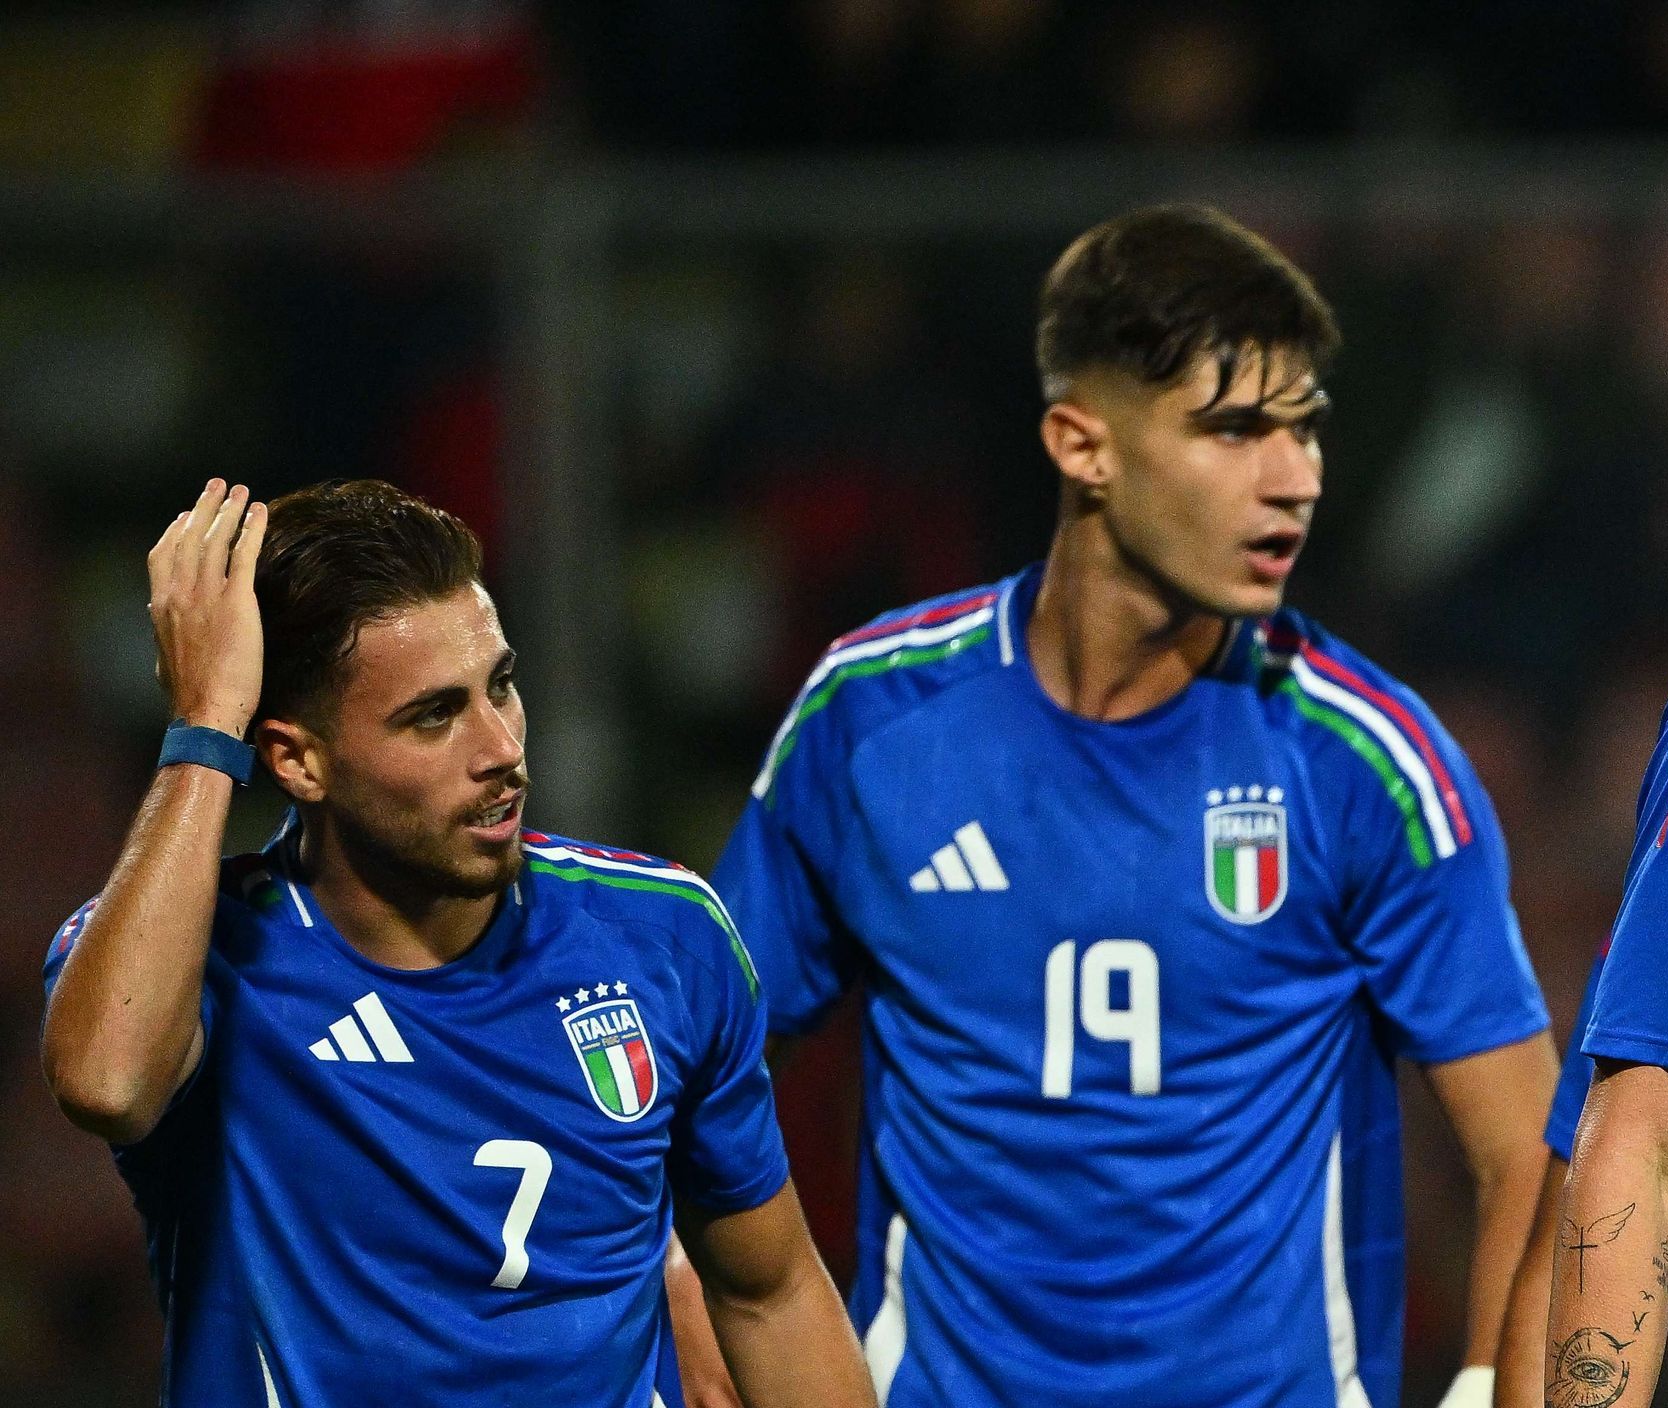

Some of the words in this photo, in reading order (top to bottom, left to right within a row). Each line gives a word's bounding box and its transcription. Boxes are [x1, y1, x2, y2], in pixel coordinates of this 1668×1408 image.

[571, 1008, 637, 1044] ITALIA
[1042, 938, 1162, 1098] 19
[473, 1139, 552, 1289] 7
